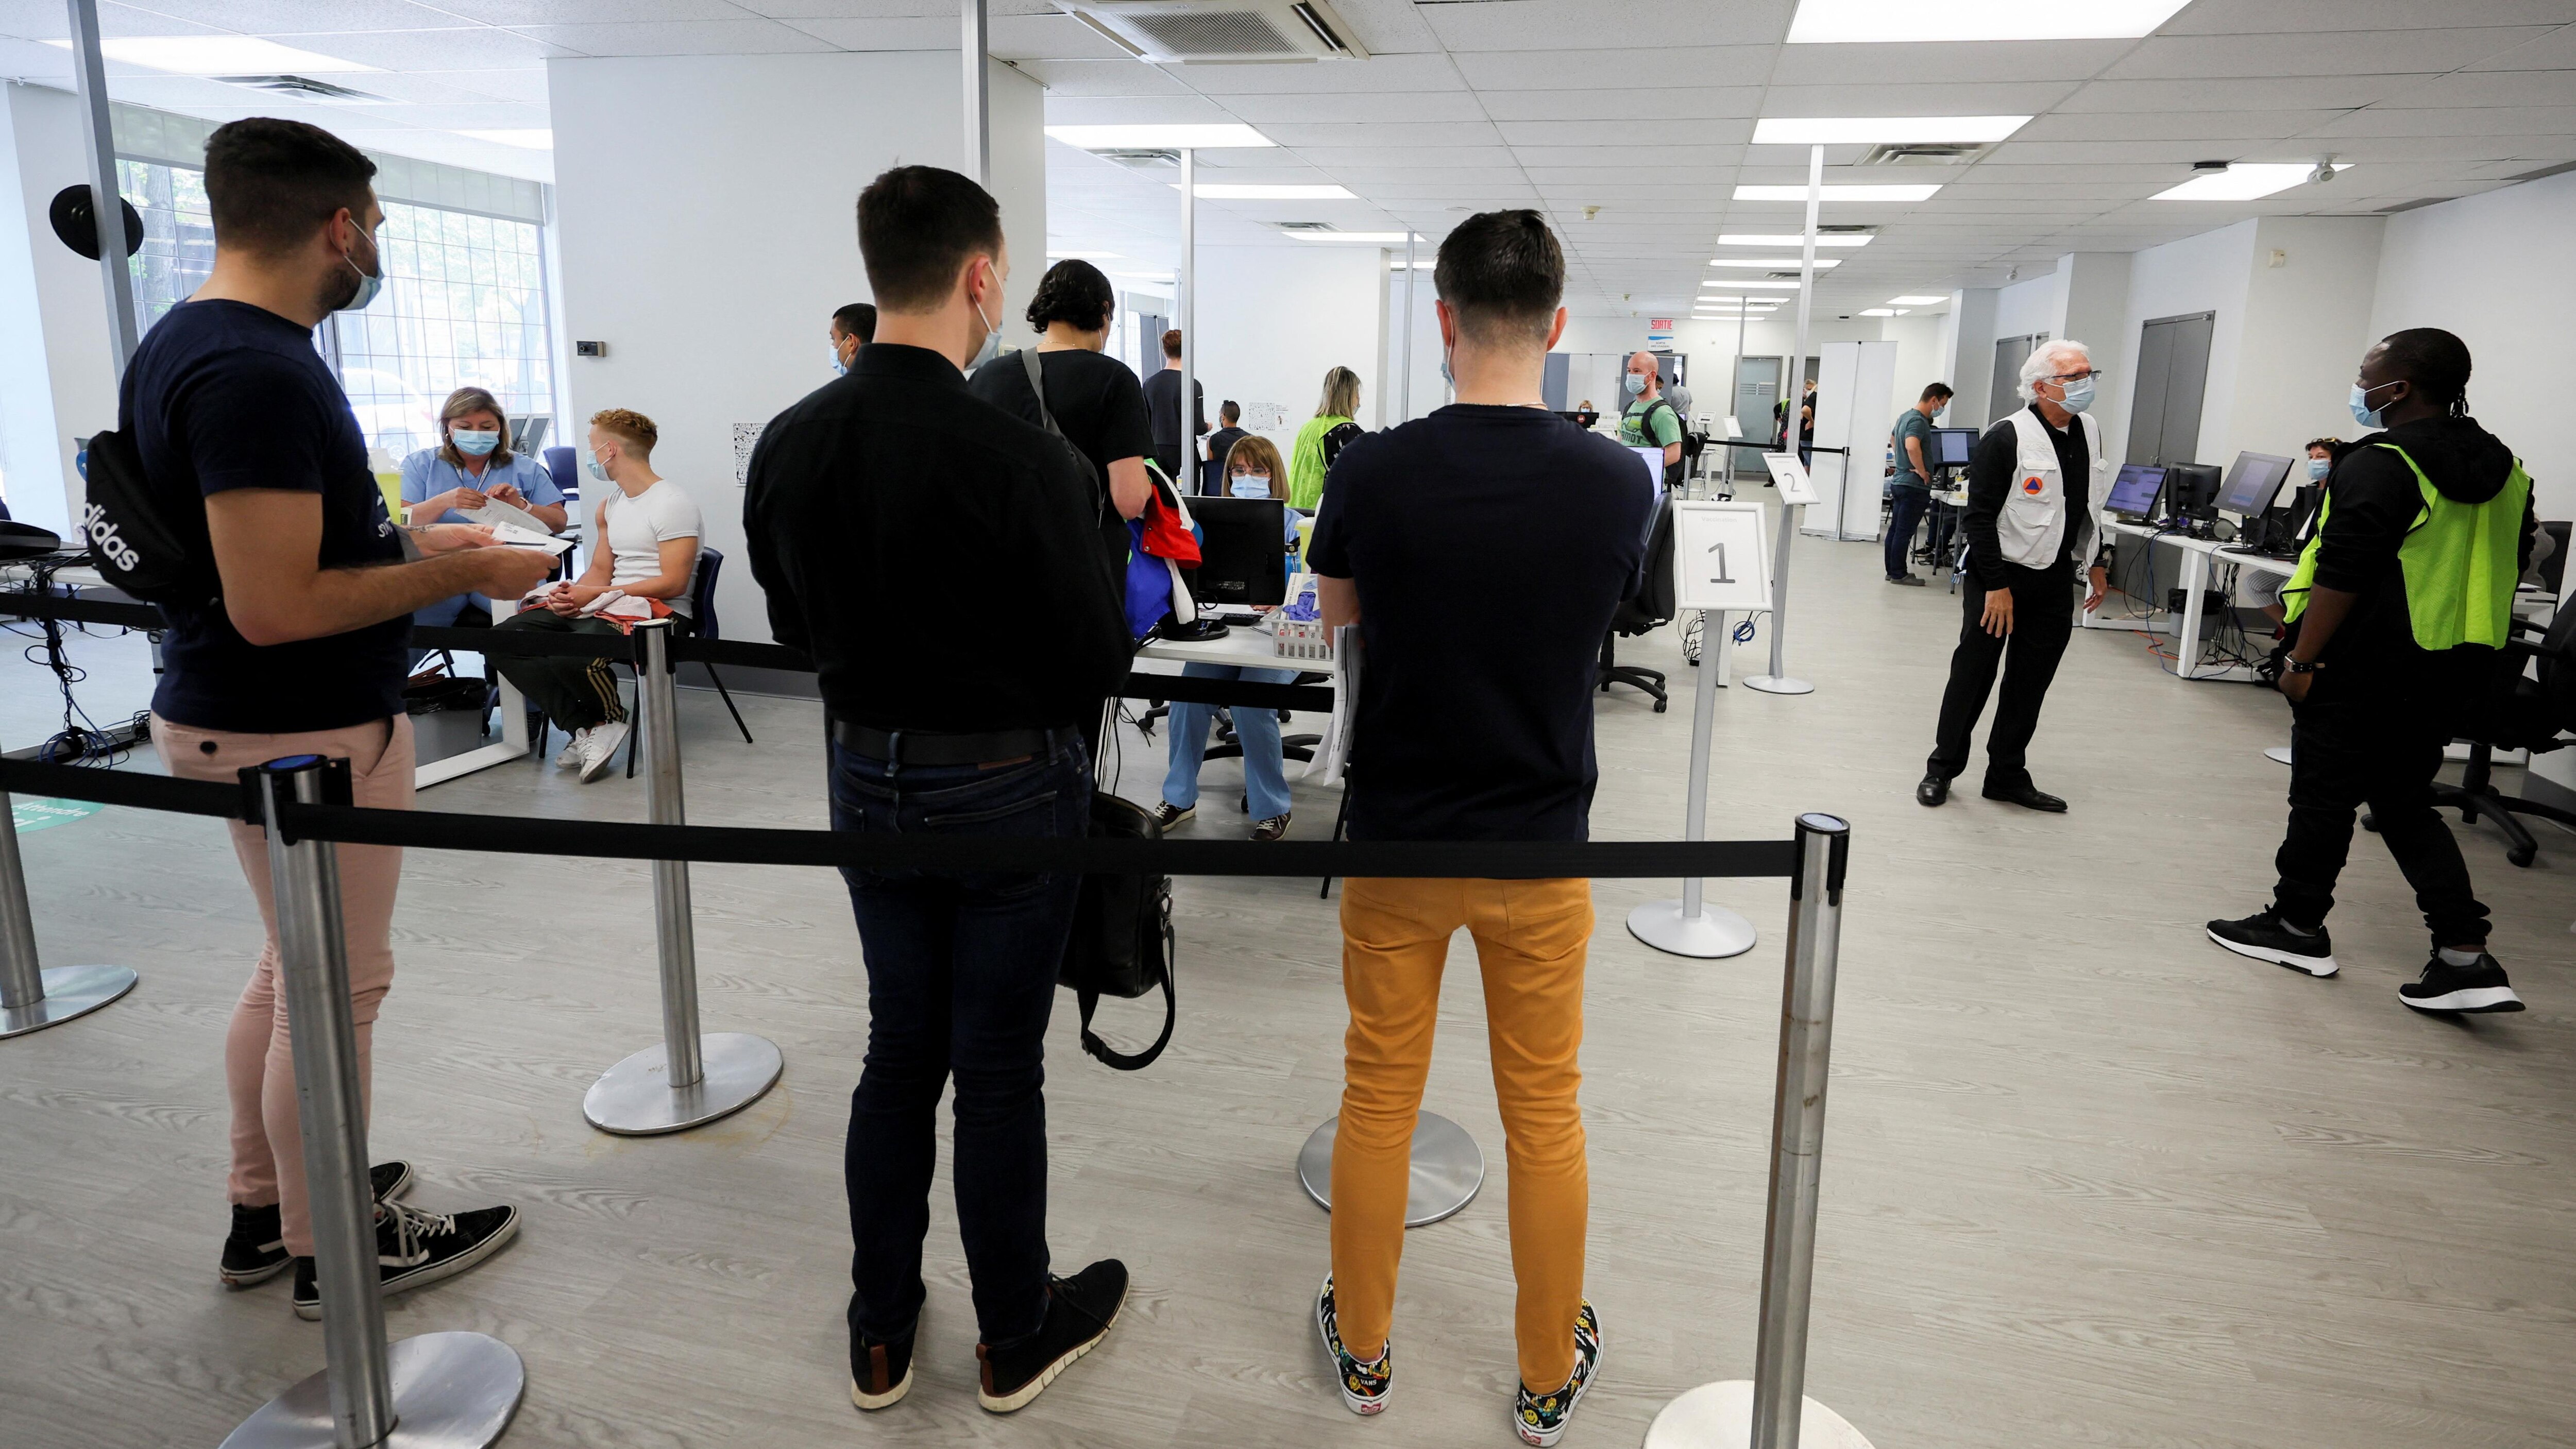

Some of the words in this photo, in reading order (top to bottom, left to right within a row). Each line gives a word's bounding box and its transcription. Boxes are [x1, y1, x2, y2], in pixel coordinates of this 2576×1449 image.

[1651, 320, 1673, 329] SORTIE
[1784, 473, 1801, 492] 2
[84, 502, 140, 571] didas
[1708, 542, 1736, 584] 1
[11, 803, 90, 816] Attendre
